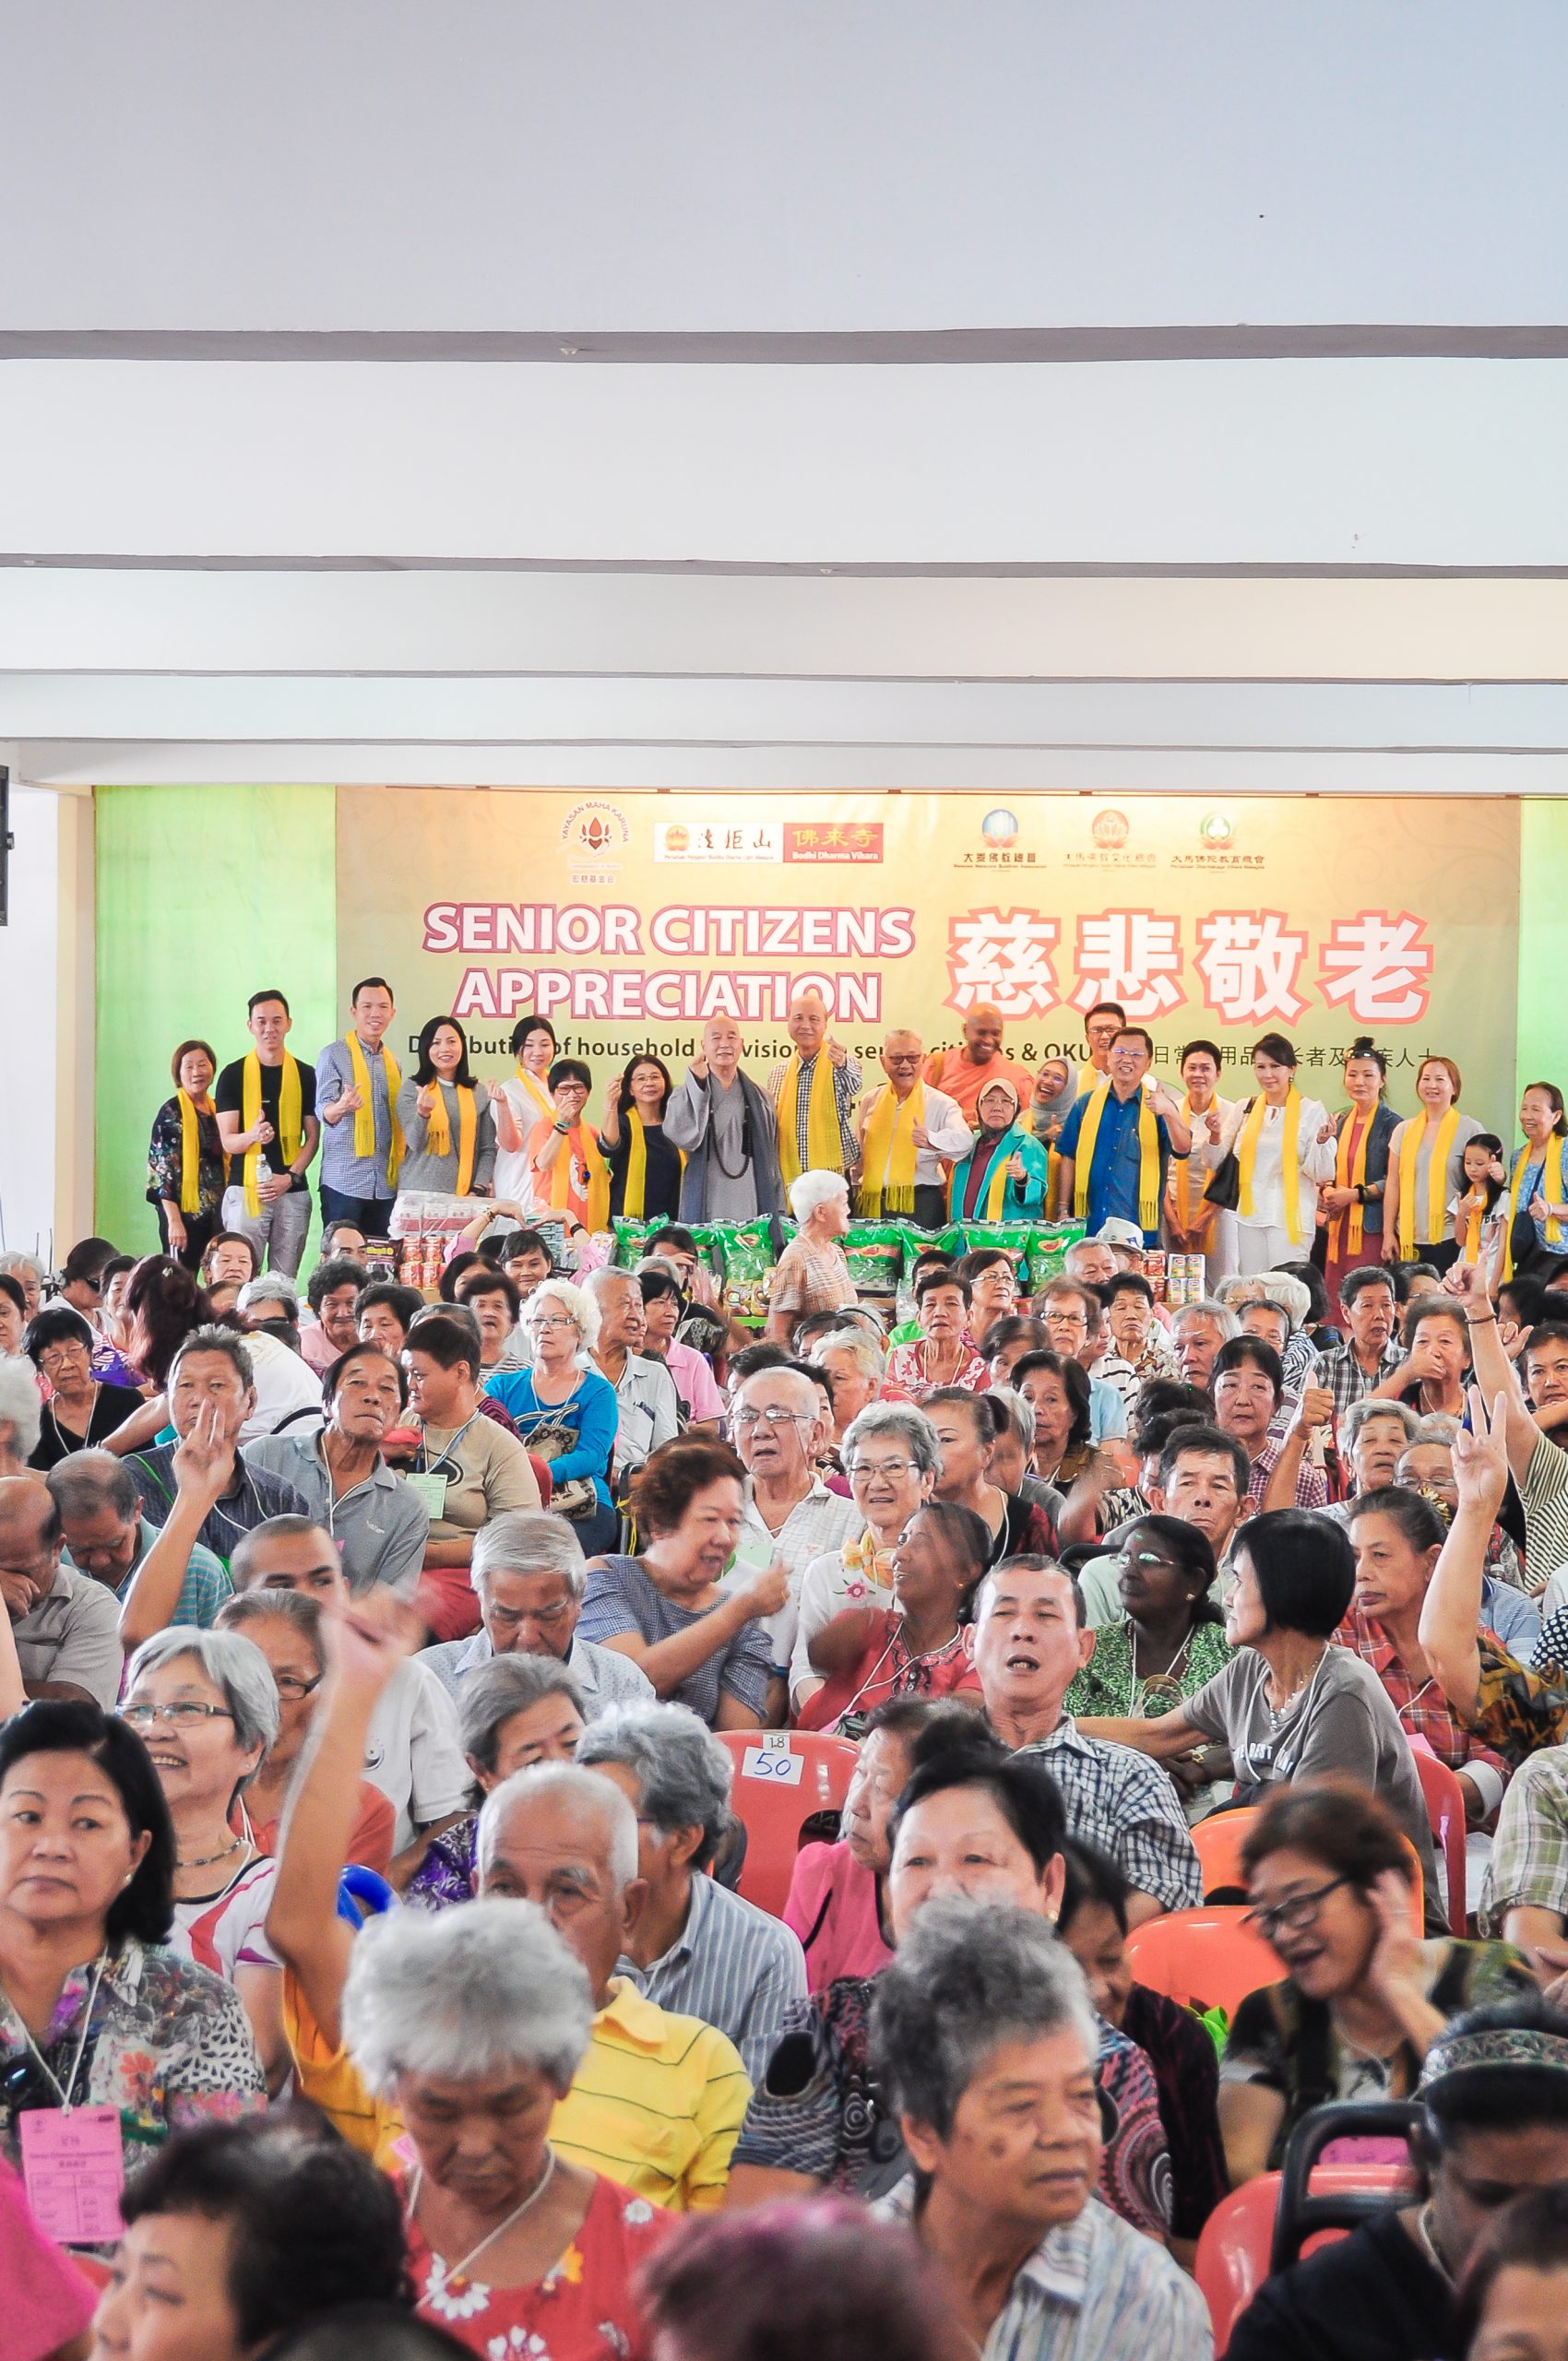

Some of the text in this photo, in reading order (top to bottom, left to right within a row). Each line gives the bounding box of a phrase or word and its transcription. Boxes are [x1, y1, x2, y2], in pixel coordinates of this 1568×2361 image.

[561, 801, 630, 843] YAYASAN MAHA KARUNA
[792, 850, 879, 860] Bodhi Dharma Vihara
[423, 903, 914, 958] SENIOR CITIZENS
[945, 908, 1431, 1024] 慈悲敬老
[452, 968, 881, 1022] APPRECIATION
[553, 1036, 572, 1055] of
[577, 1038, 695, 1057] household
[1021, 1042, 1038, 1062] &
[1044, 1043, 1092, 1062] OKU
[754, 1752, 791, 1775] 50
